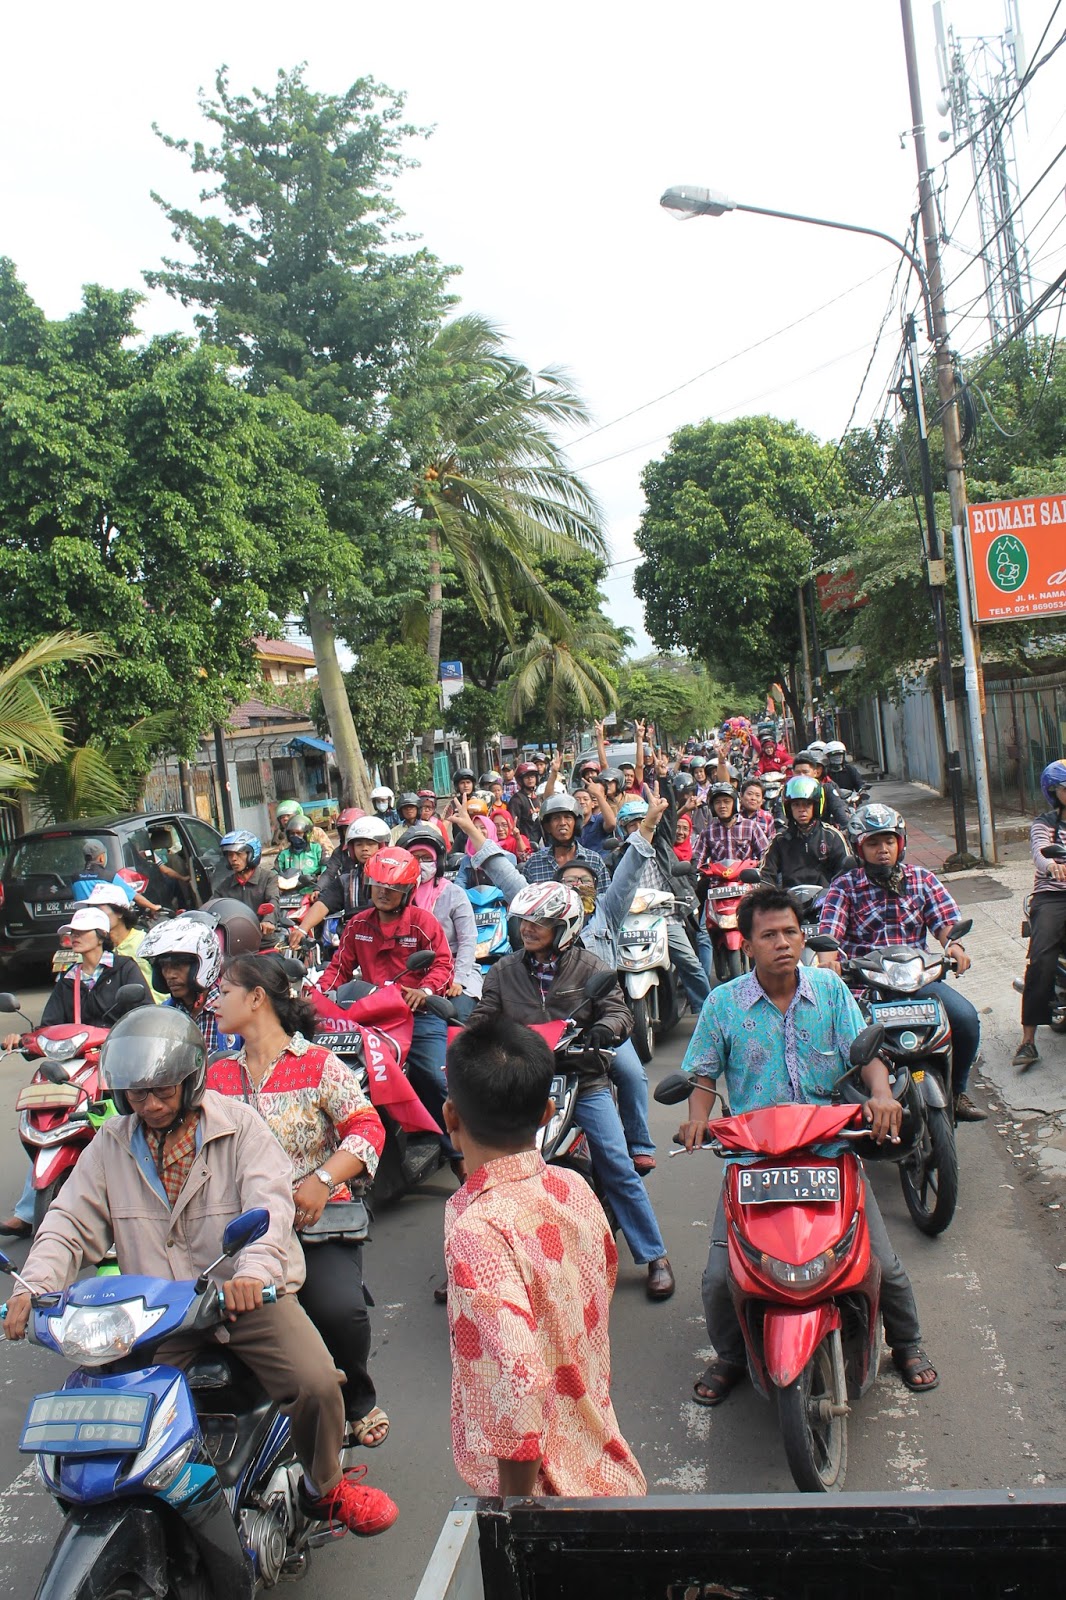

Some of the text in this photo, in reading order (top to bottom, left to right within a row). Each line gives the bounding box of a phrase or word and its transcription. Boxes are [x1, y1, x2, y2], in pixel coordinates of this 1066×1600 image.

[972, 503, 1037, 534] RUMAH
[1039, 590, 1066, 600] NAMA
[989, 607, 1013, 616] TELP.
[1014, 604, 1030, 613] 021
[36, 903, 42, 912] B
[742, 1170, 837, 1187] B 3715 TRS
